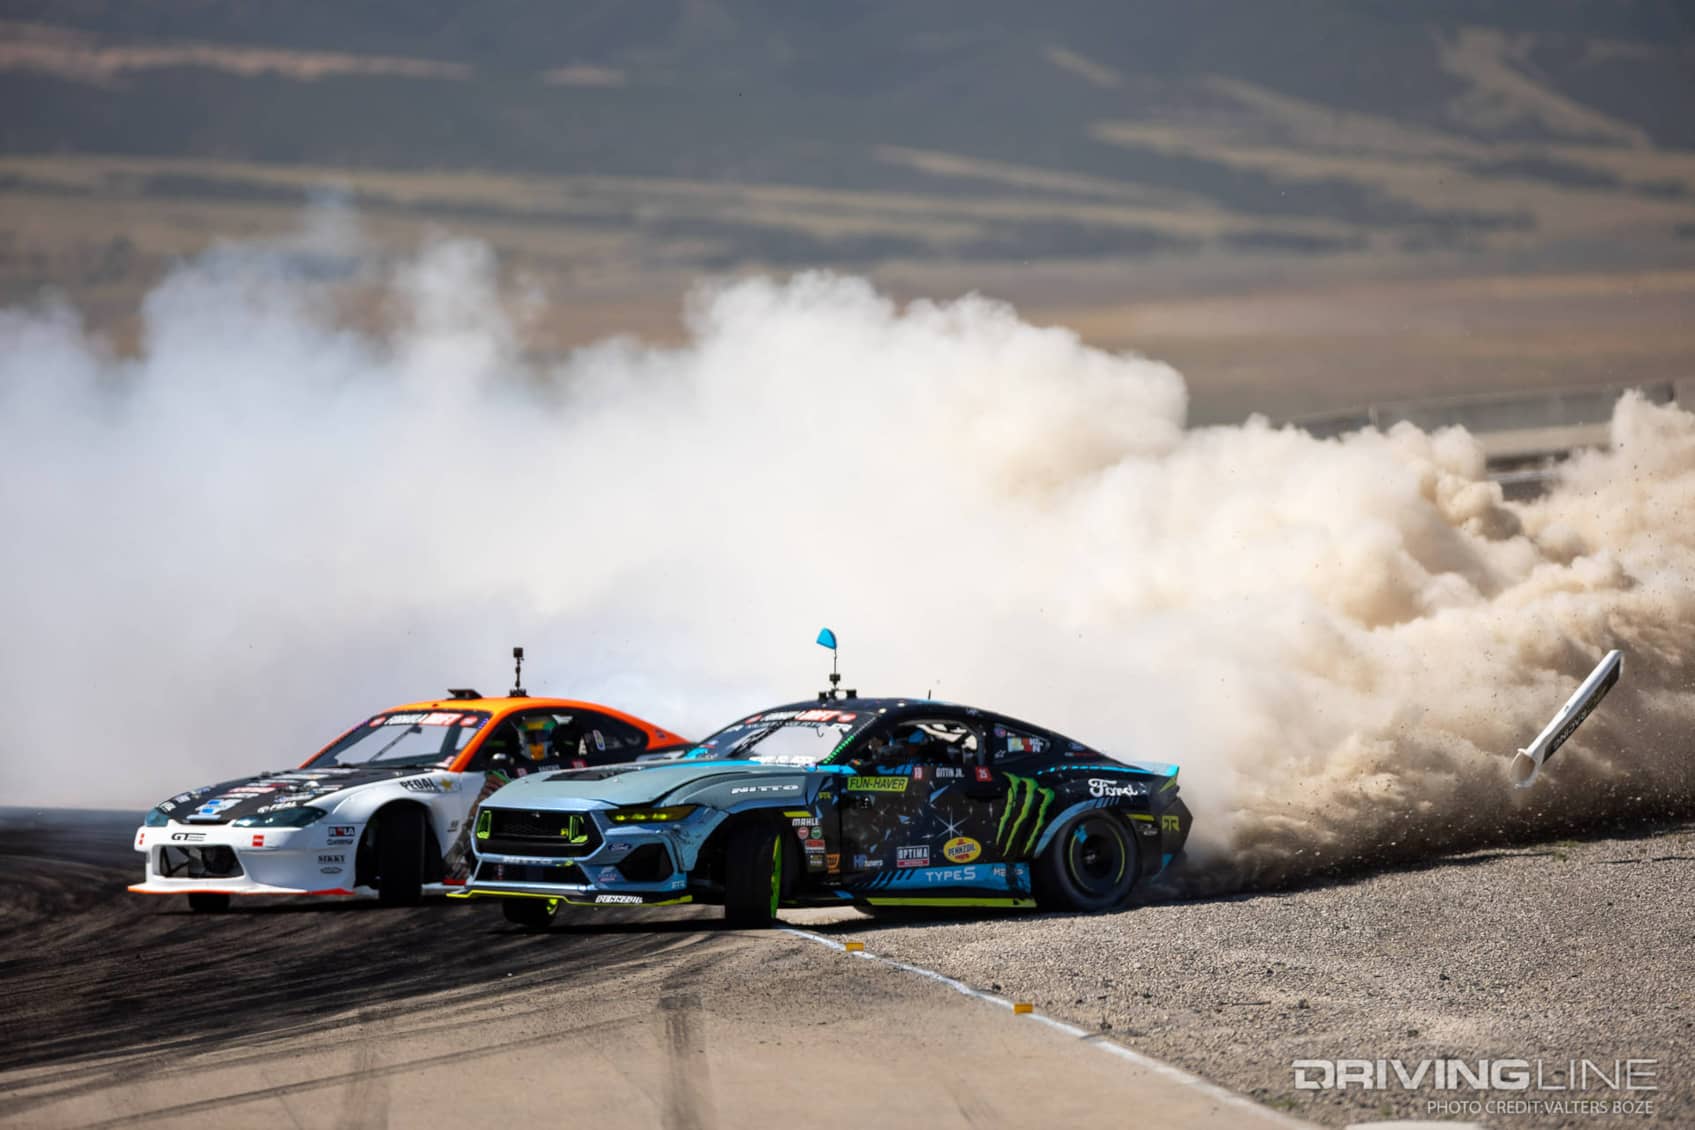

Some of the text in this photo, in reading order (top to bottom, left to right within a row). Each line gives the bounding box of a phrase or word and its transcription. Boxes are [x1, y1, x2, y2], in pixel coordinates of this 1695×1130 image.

[400, 777, 436, 792] PEDAL
[731, 784, 799, 794] NITTO
[849, 778, 907, 791] FUN-HAVER
[1088, 778, 1139, 797] Ford
[792, 818, 819, 827] MAHLE
[897, 848, 928, 859] OPTIMA
